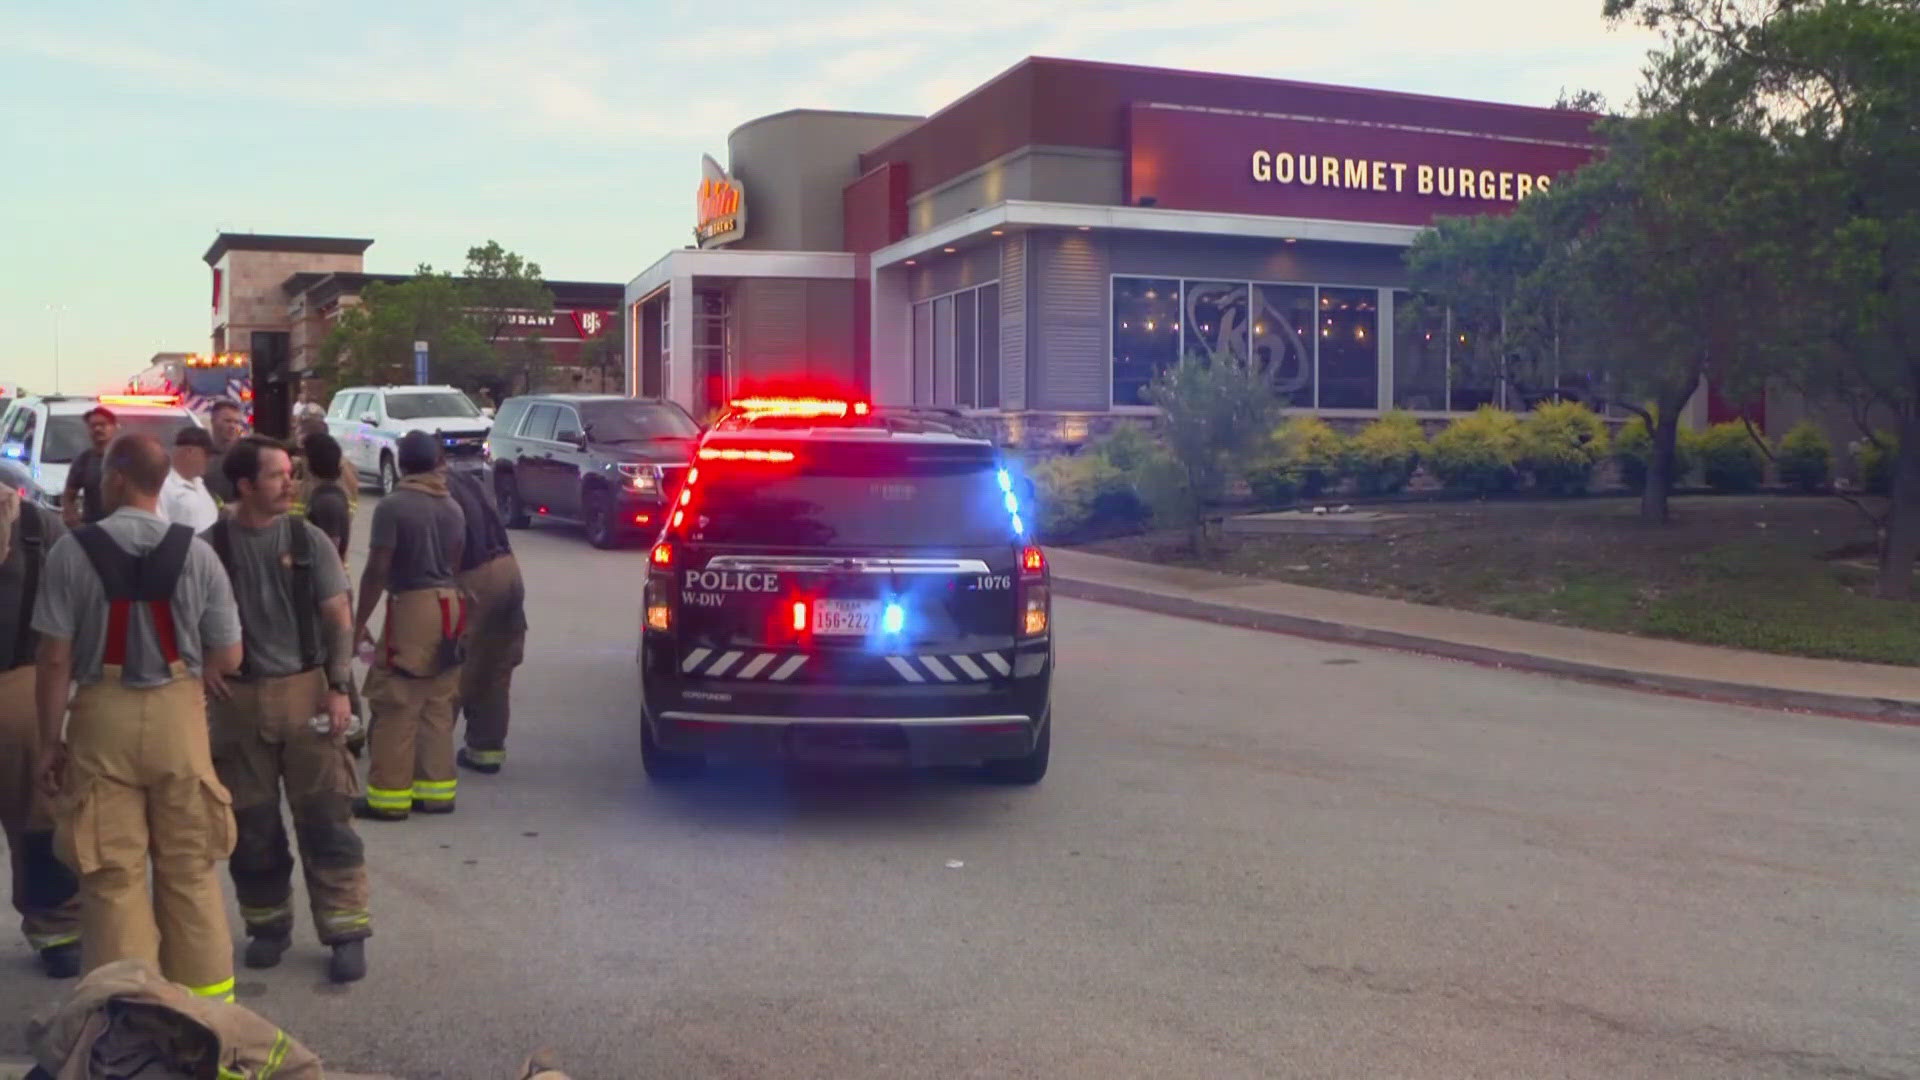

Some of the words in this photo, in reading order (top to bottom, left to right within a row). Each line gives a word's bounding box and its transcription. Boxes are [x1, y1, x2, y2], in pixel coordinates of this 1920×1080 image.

[1252, 150, 1407, 192] GOURMET
[1418, 164, 1552, 201] BURGERS
[684, 569, 779, 593] POLICE
[976, 575, 1012, 591] 1076
[681, 591, 726, 607] W-DIV
